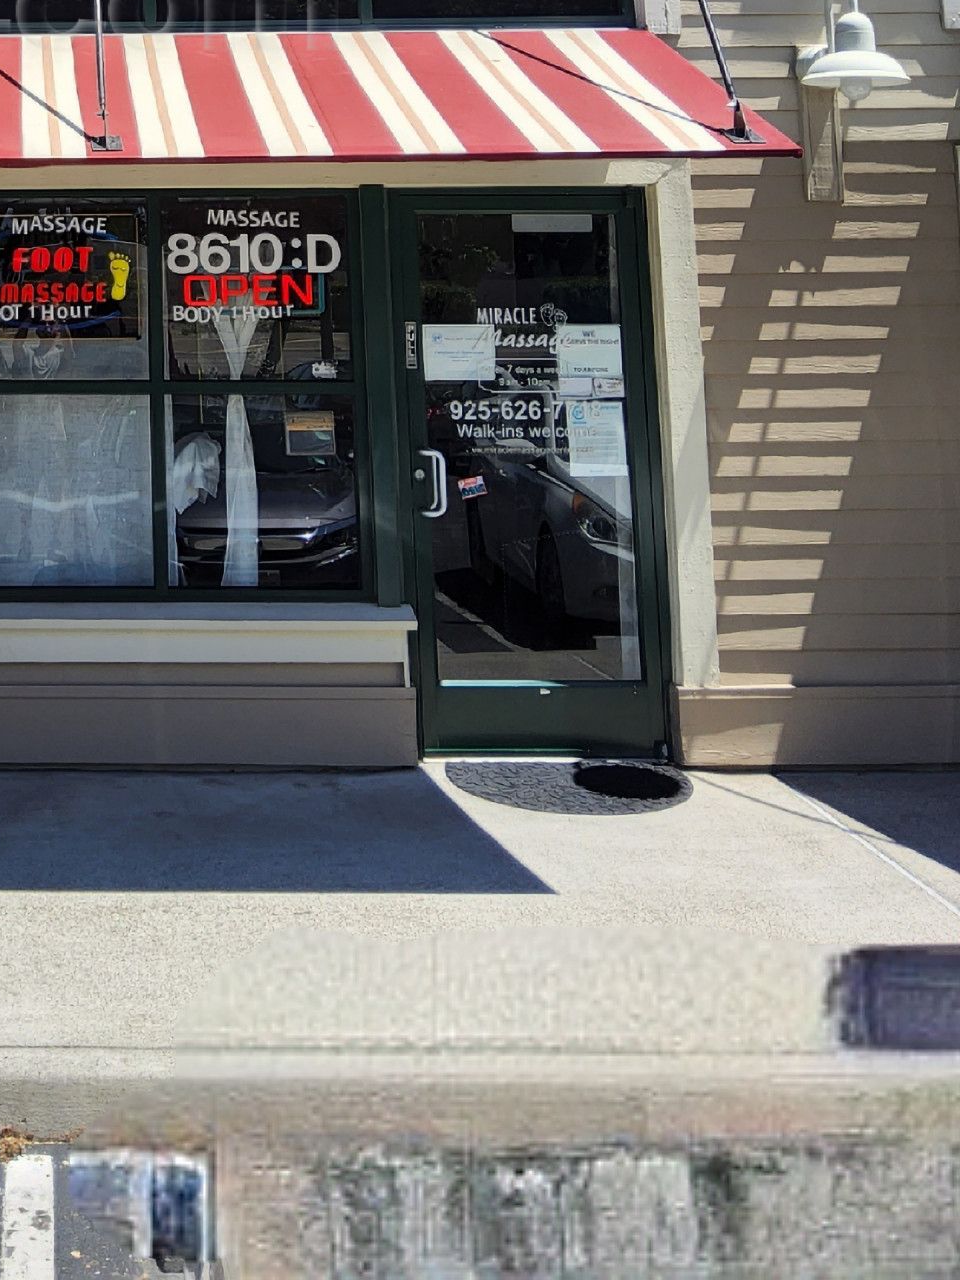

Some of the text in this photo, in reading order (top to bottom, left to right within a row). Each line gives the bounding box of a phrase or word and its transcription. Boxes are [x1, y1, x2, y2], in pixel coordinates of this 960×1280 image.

[11, 215, 107, 235] MASSAGE
[207, 209, 300, 228] MASSAGE
[12, 246, 93, 273] FOOT
[0, 281, 107, 303] MASSAGE
[183, 274, 313, 306] OPEN
[28, 306, 35, 318] 1
[41, 304, 93, 321] Hour
[172, 305, 295, 323] BODY 1 Hour
[476, 307, 537, 325] MIRACLE
[407, 325, 415, 357] PULL
[456, 424, 524, 438] Walk-ins
